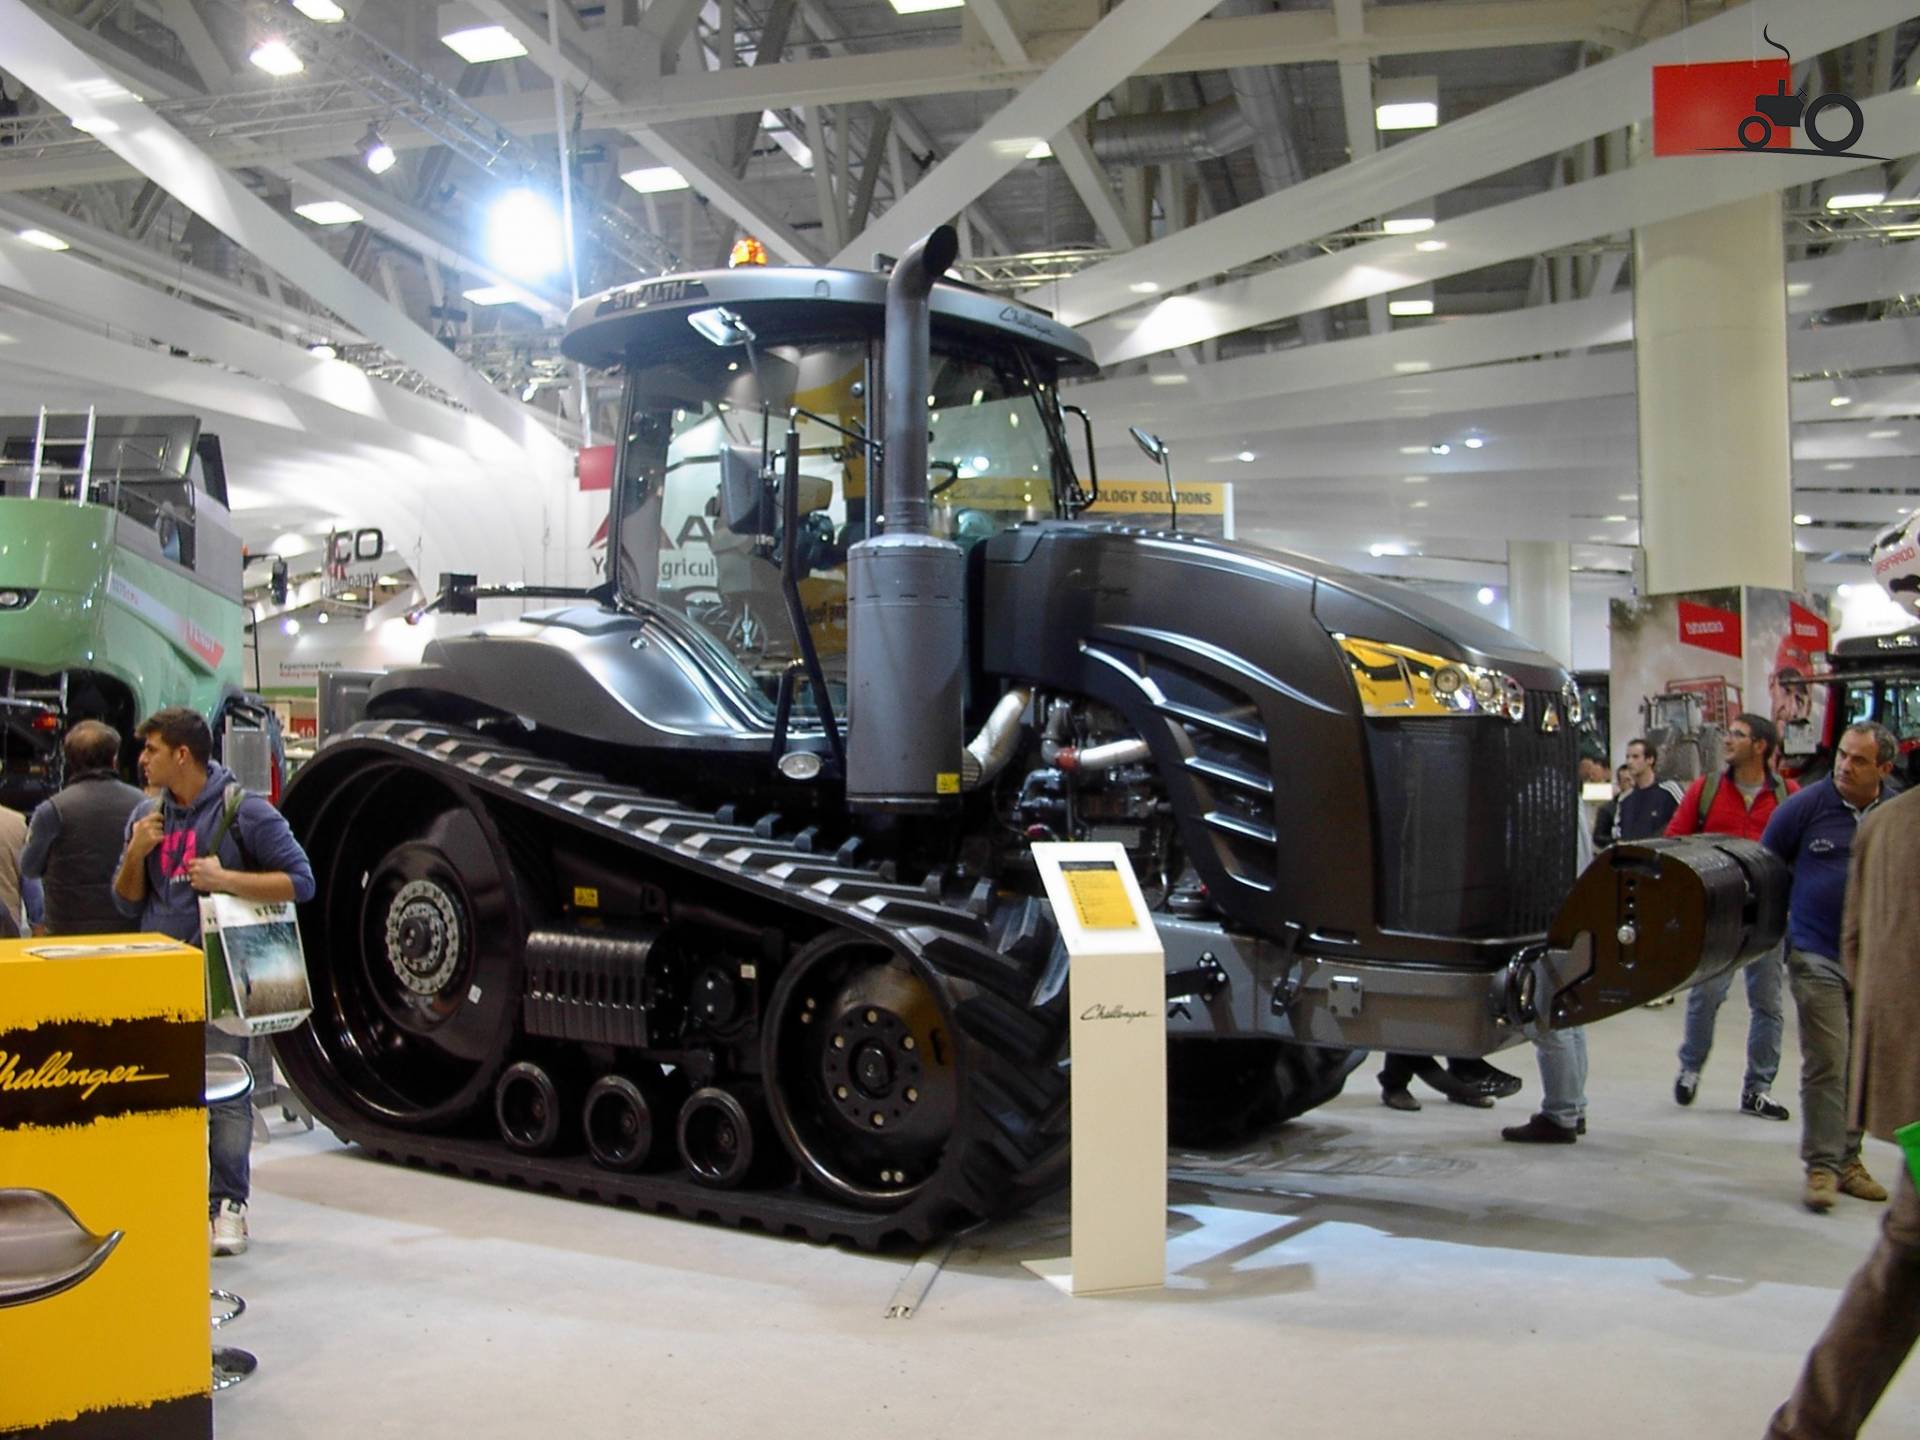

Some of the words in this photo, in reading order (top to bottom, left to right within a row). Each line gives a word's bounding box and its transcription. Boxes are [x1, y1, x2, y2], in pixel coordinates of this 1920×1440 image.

[614, 281, 686, 309] STEALTH
[661, 558, 715, 580] gricul
[1080, 1003, 1157, 1024] Challenger
